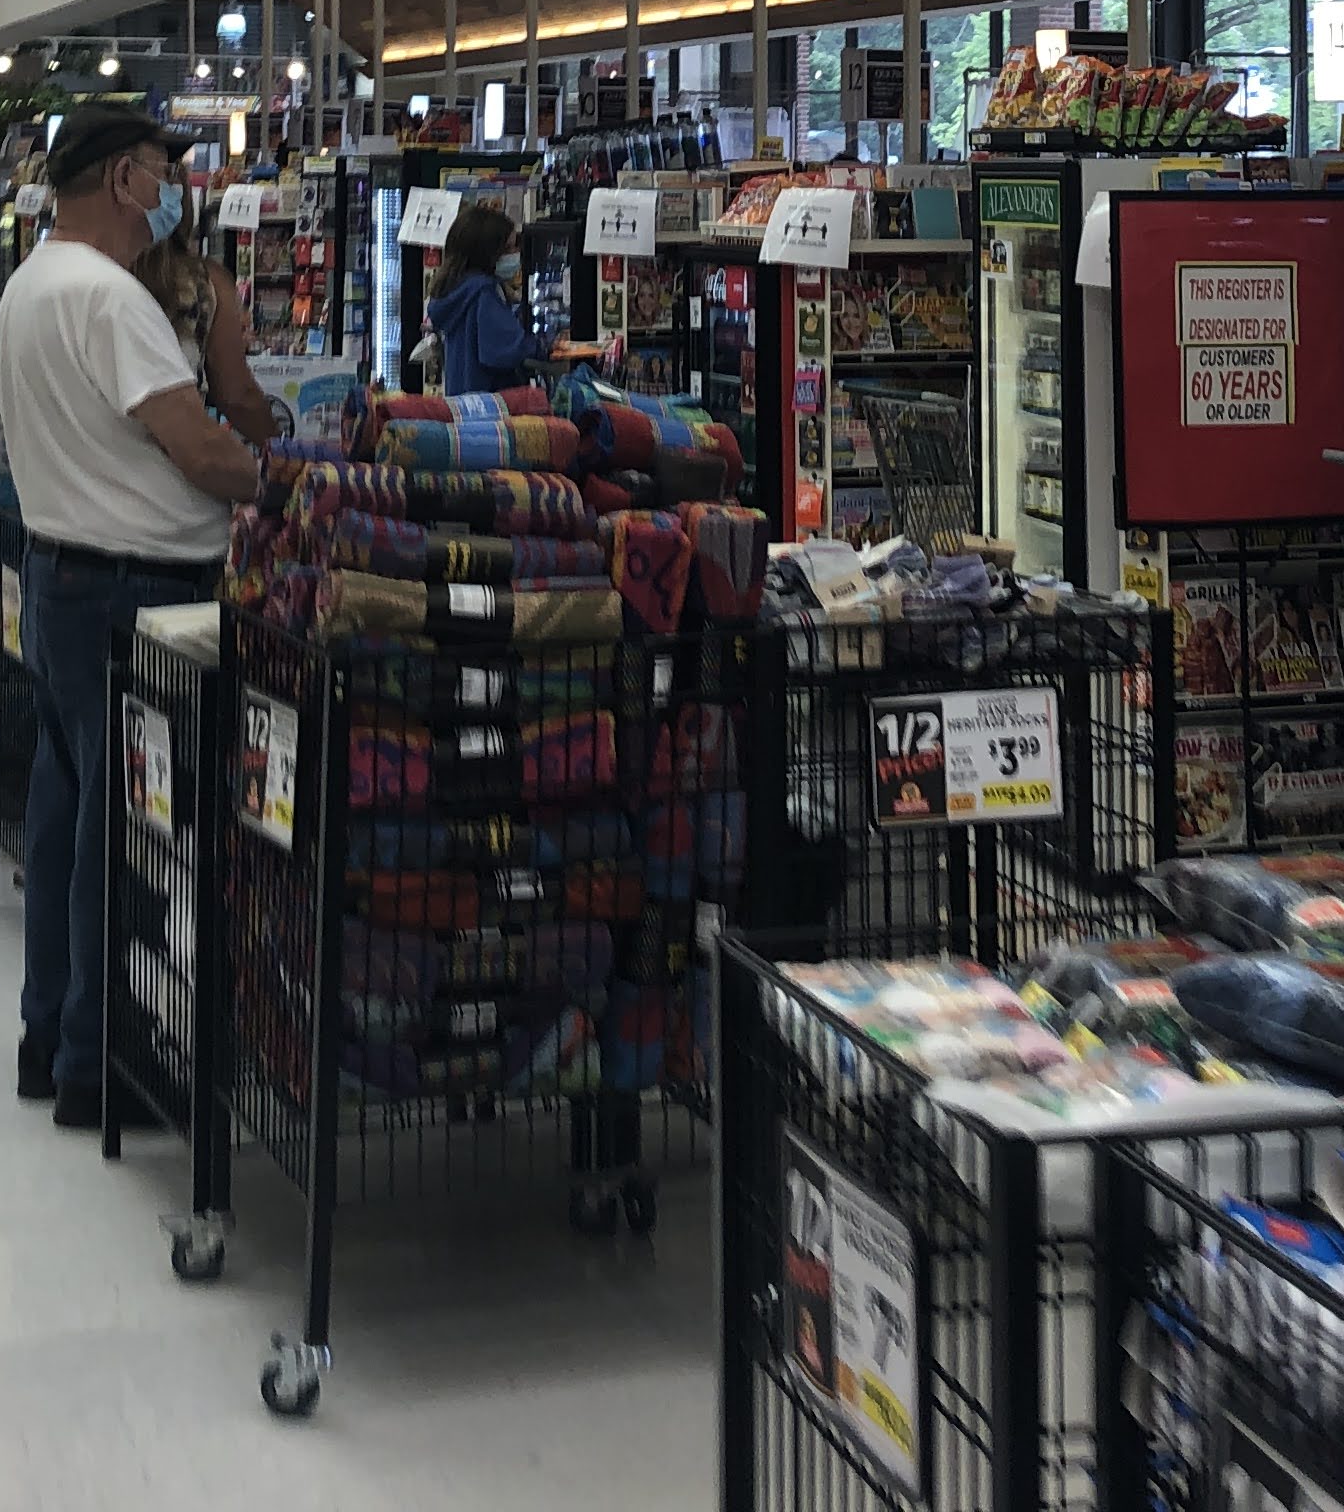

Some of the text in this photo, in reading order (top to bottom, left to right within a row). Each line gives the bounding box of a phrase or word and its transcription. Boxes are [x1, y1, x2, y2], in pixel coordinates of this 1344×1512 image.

[847, 62, 864, 92] 12
[1188, 277, 1286, 302] THIS REGISTER IS
[1188, 317, 1288, 342] DESIGNATED FOR
[1198, 349, 1276, 368] CUSTOMERS
[1190, 369, 1284, 402] 60 YEARS
[1205, 402, 1272, 422] OR OLDER
[876, 710, 941, 758] 1/2
